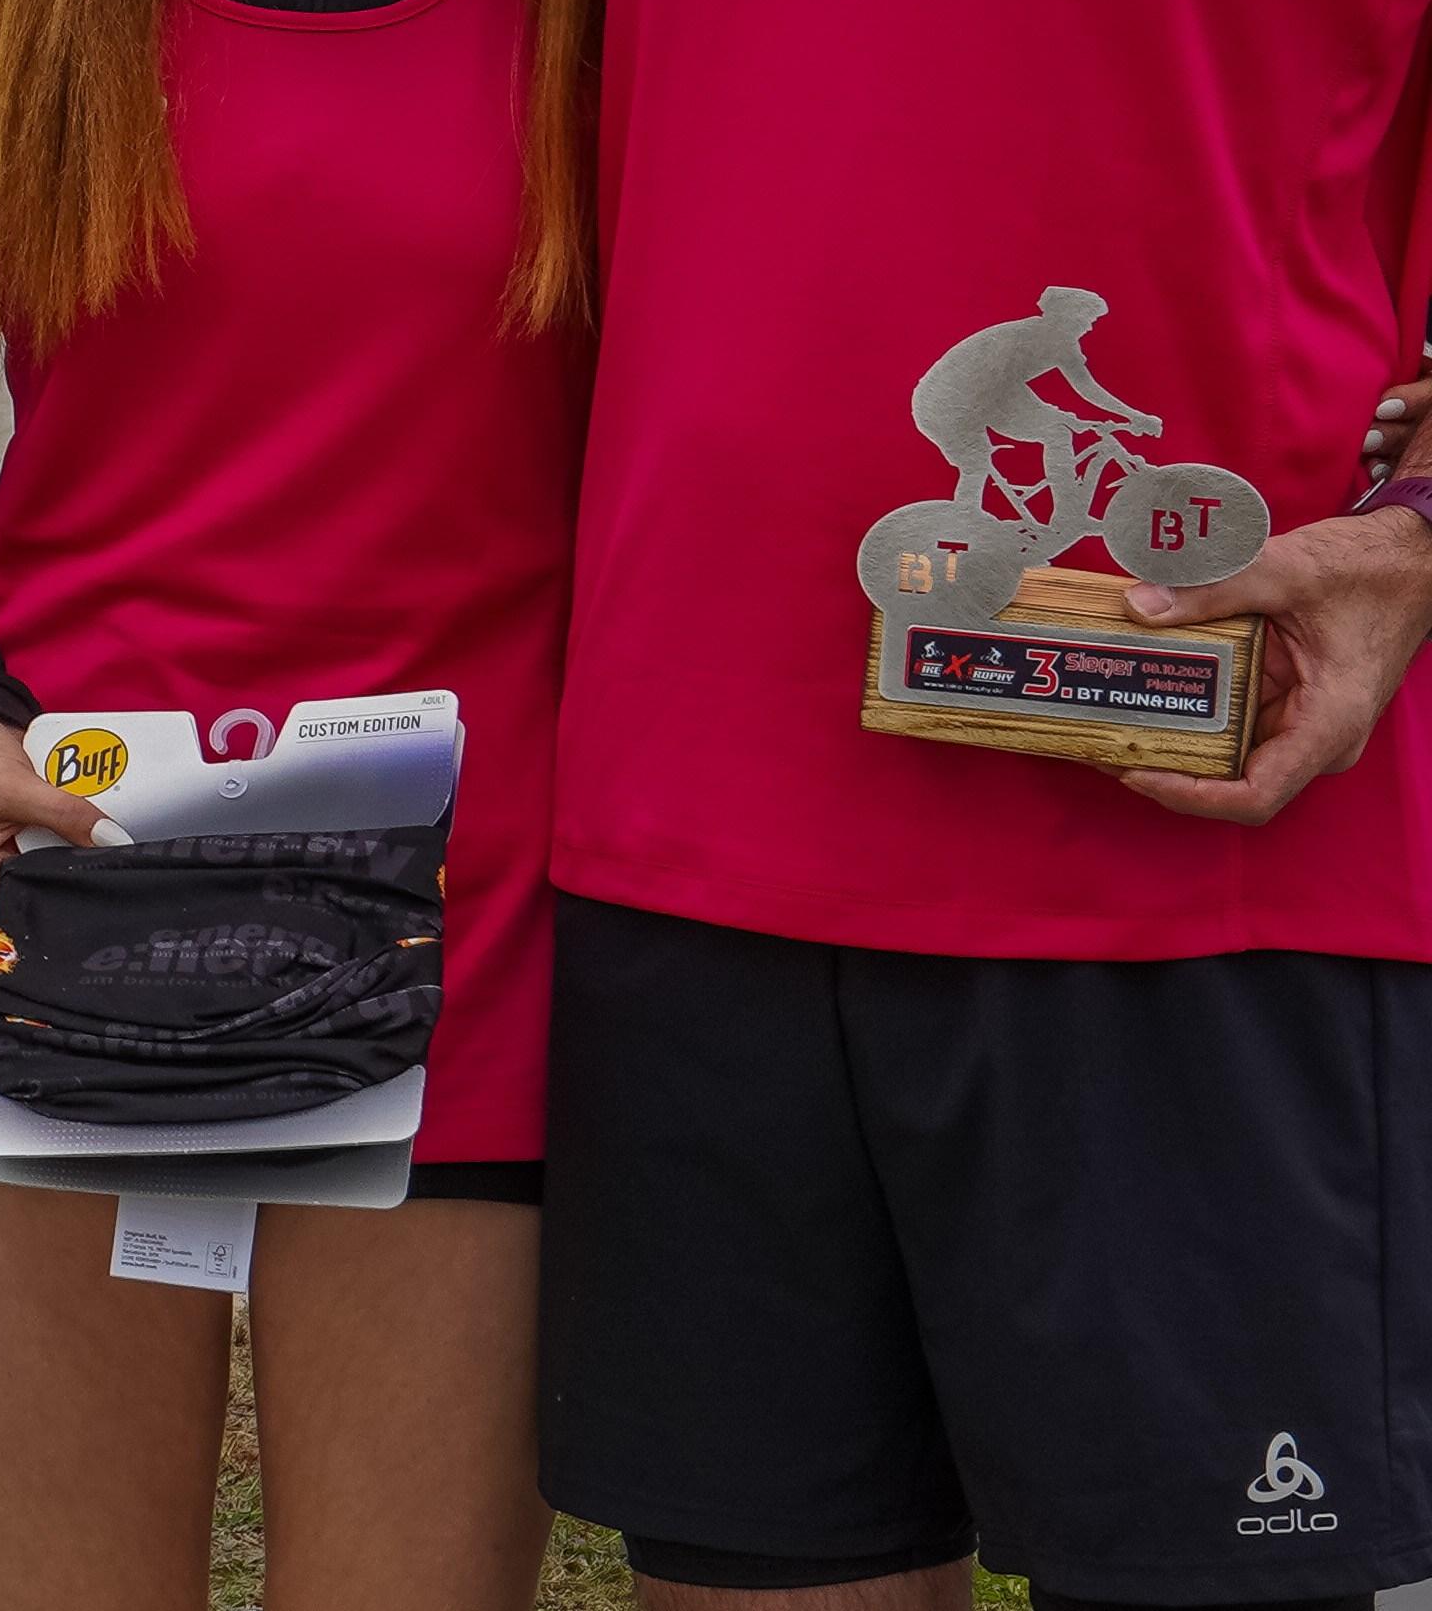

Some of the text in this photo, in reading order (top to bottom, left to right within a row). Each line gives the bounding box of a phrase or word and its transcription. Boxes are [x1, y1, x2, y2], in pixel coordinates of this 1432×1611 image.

[1149, 497, 1222, 550] BT
[898, 540, 969, 595] BT
[1064, 651, 1138, 679] Sieger
[421, 694, 447, 705] ADULT
[1145, 678, 1206, 695] Pleinfeld
[1077, 687, 1209, 713] BT RUN&BIKE
[298, 714, 421, 739] CUSTOM EDITION
[1236, 1508, 1339, 1535] odlo
